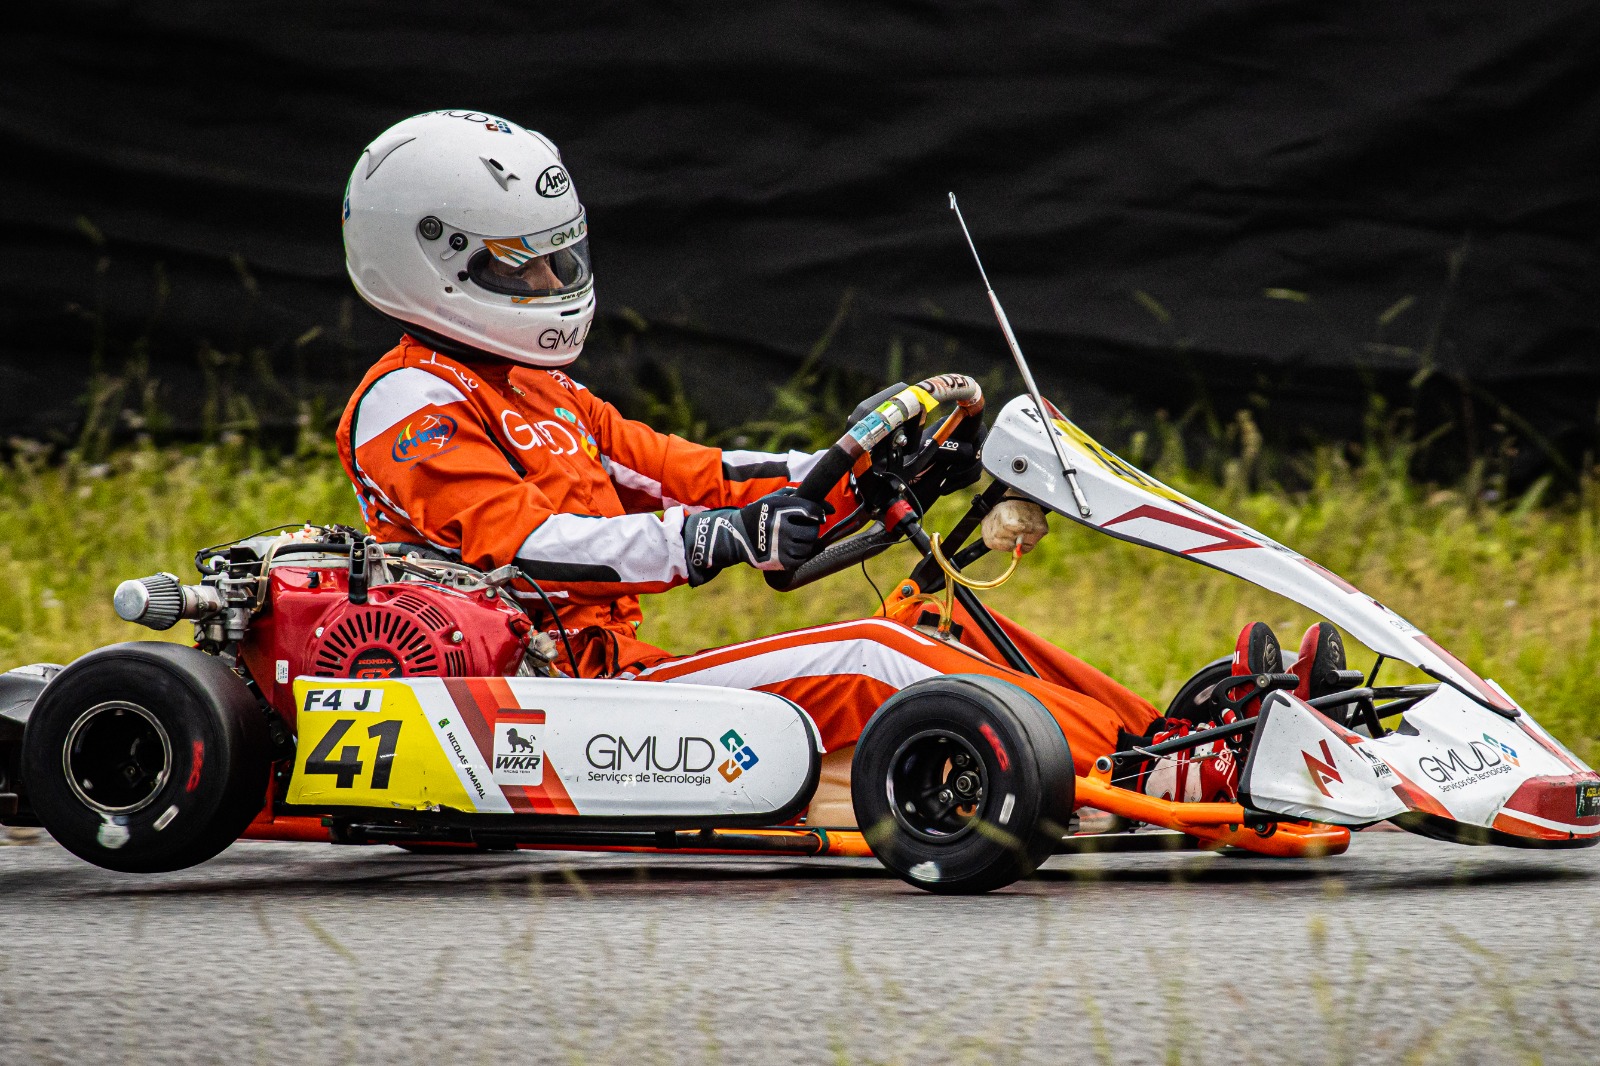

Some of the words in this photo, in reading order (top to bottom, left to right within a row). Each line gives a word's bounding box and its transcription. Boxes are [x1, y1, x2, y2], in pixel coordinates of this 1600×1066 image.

[398, 423, 451, 456] Prime
[355, 667, 396, 679] GX
[304, 689, 342, 711] F4
[353, 689, 372, 711] J
[304, 719, 403, 789] 41
[446, 731, 469, 765] NICOLAS
[464, 766, 486, 800] AMARAL
[495, 756, 541, 770] WKR
[585, 733, 716, 773] GMUD
[1418, 740, 1502, 783] GMUD
[587, 771, 633, 785] Serviços
[635, 773, 650, 783] de
[652, 772, 711, 787] Tecnologia
[1438, 779, 1468, 793] Serviços
[1466, 775, 1478, 785] de
[1474, 763, 1513, 781] Tecnologia
